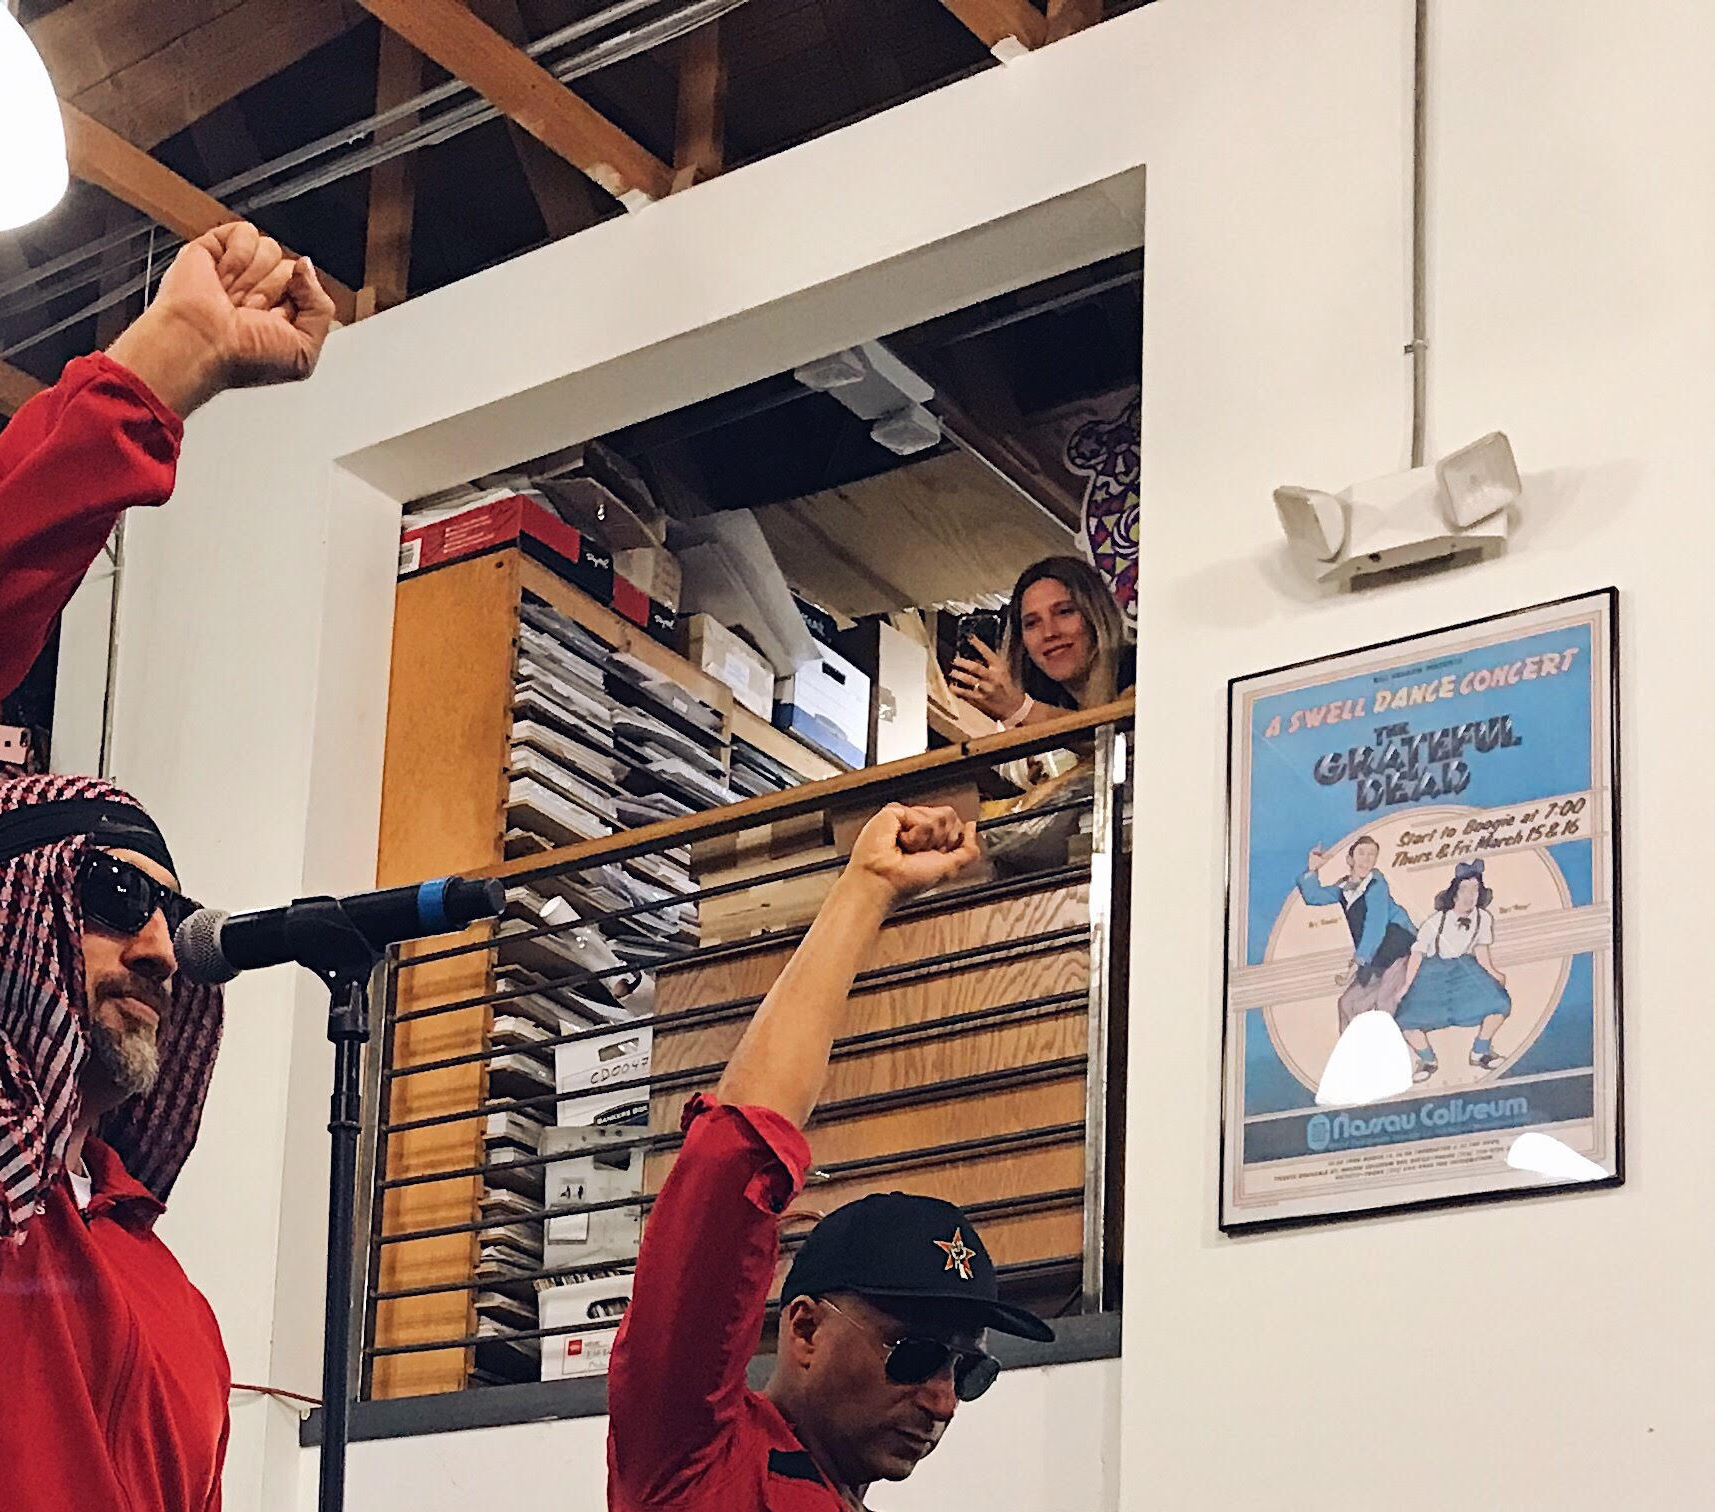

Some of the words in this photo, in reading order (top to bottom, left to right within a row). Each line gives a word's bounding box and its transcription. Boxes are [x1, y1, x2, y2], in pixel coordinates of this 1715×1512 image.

[1265, 715, 1281, 737] A
[1288, 698, 1366, 734] SWELL
[1373, 674, 1456, 713] DANCE
[1459, 648, 1579, 696] CONCERT
[1313, 714, 1522, 786] GRATEFUL
[1374, 721, 1410, 747] THE
[1356, 761, 1470, 811] DEAD
[1397, 829, 1438, 847] Start
[1441, 826, 1457, 840] to
[1462, 814, 1515, 836] Boogie
[1520, 809, 1539, 824] at
[1544, 797, 1586, 820] 7:00
[1435, 843, 1448, 860] &
[1475, 831, 1523, 852] March
[1525, 824, 1546, 843] 15
[1545, 822, 1560, 838] &
[1561, 818, 1581, 836] 16
[1332, 1112, 1417, 1140] Nassau
[1420, 1097, 1528, 1127] Coliseum
